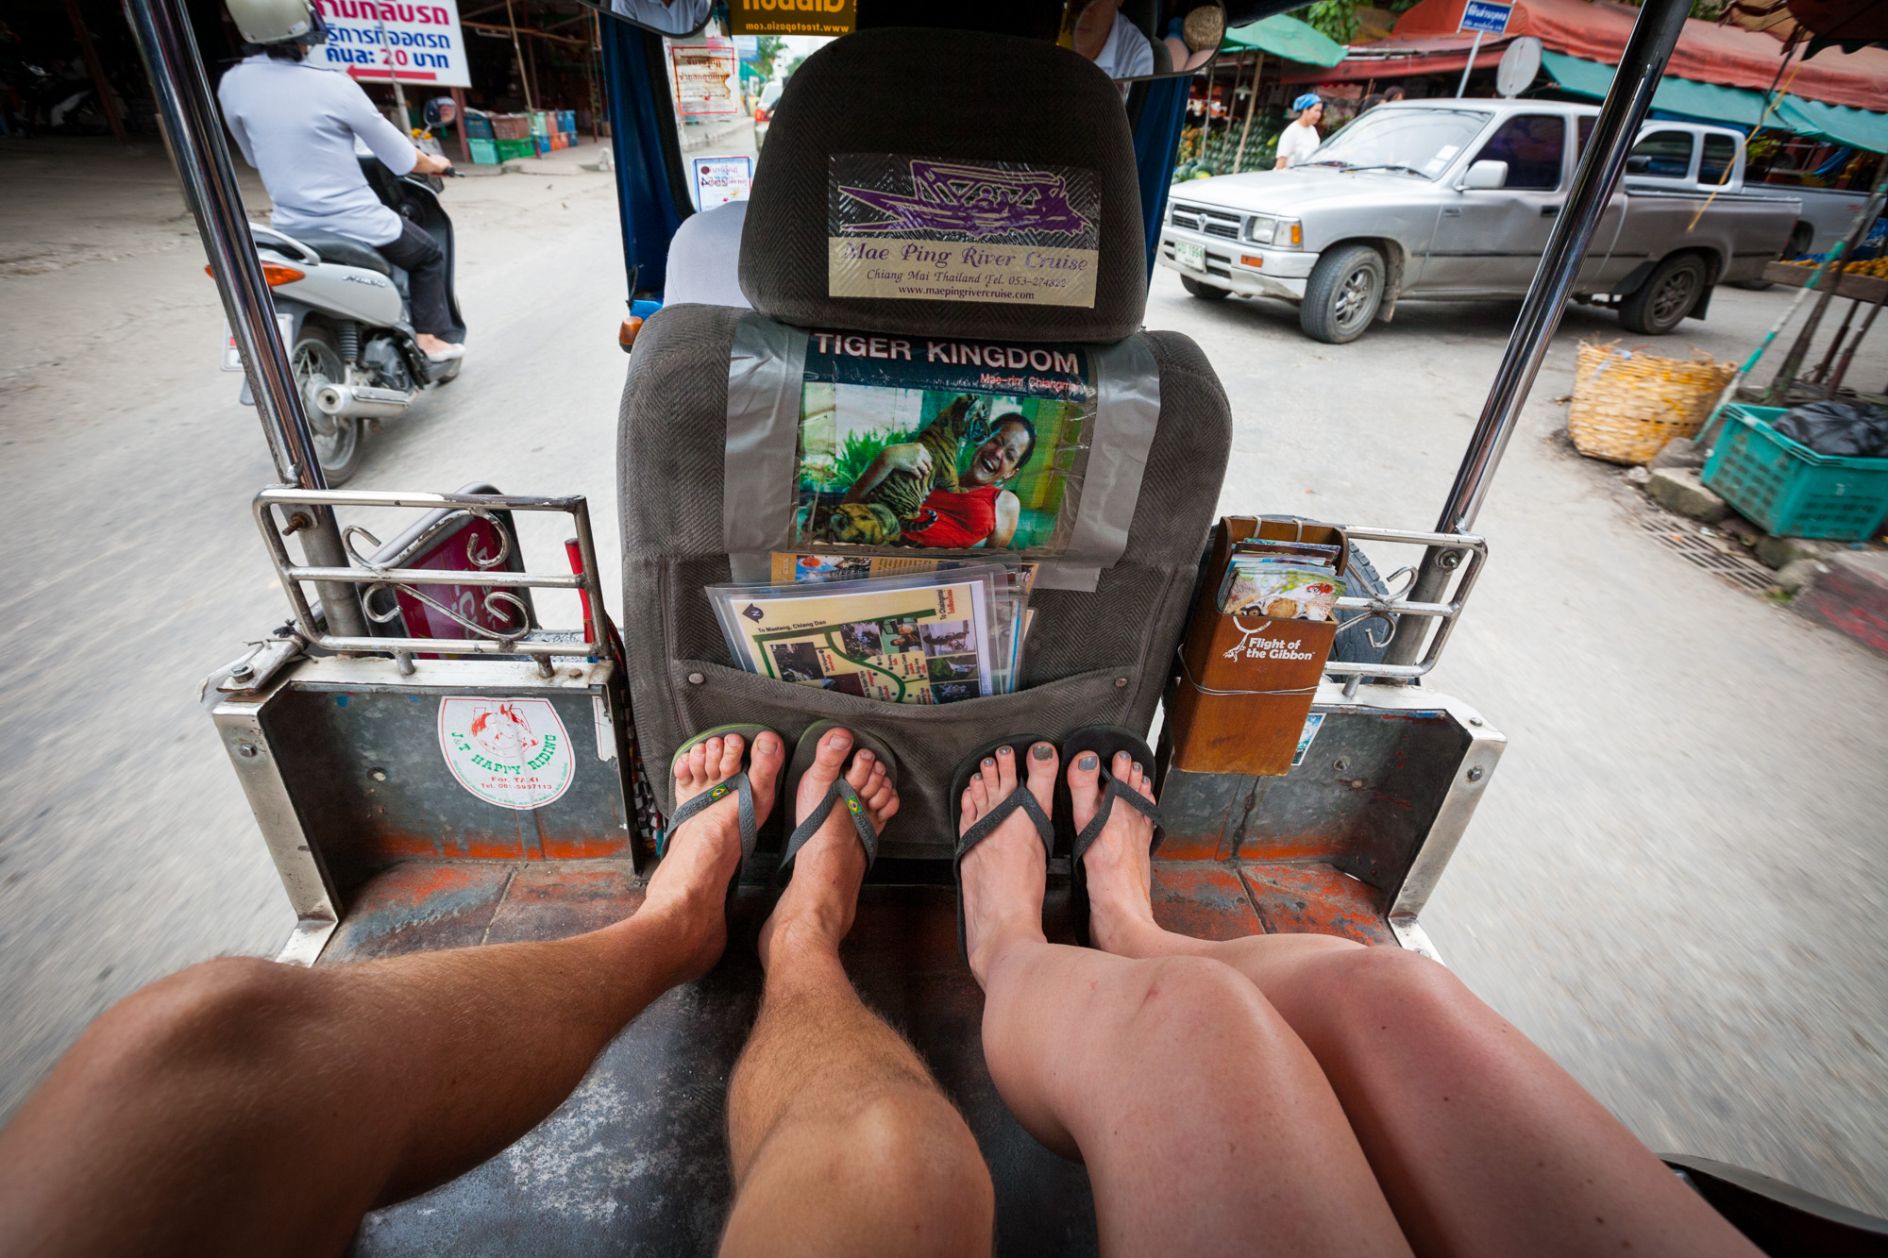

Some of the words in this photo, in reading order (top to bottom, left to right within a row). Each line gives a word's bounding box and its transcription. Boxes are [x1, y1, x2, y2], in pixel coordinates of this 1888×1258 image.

[380, 49, 408, 66] 20
[413, 52, 450, 69] บาท
[843, 242, 890, 261] Mae
[901, 243, 952, 268] Ping
[961, 245, 1016, 268] River
[1025, 250, 1088, 271] Cruise
[866, 268, 903, 284] Chiang
[907, 270, 929, 282] Mai
[934, 271, 981, 284] Thailand
[898, 285, 1035, 300] www.maepingrivercruise.com
[814, 333, 912, 361] TIGER
[927, 341, 1079, 375] KINGDOM
[1249, 637, 1286, 650] Flight
[1287, 639, 1302, 650] of
[1246, 648, 1267, 659] the
[1269, 649, 1313, 660] Gibbon
